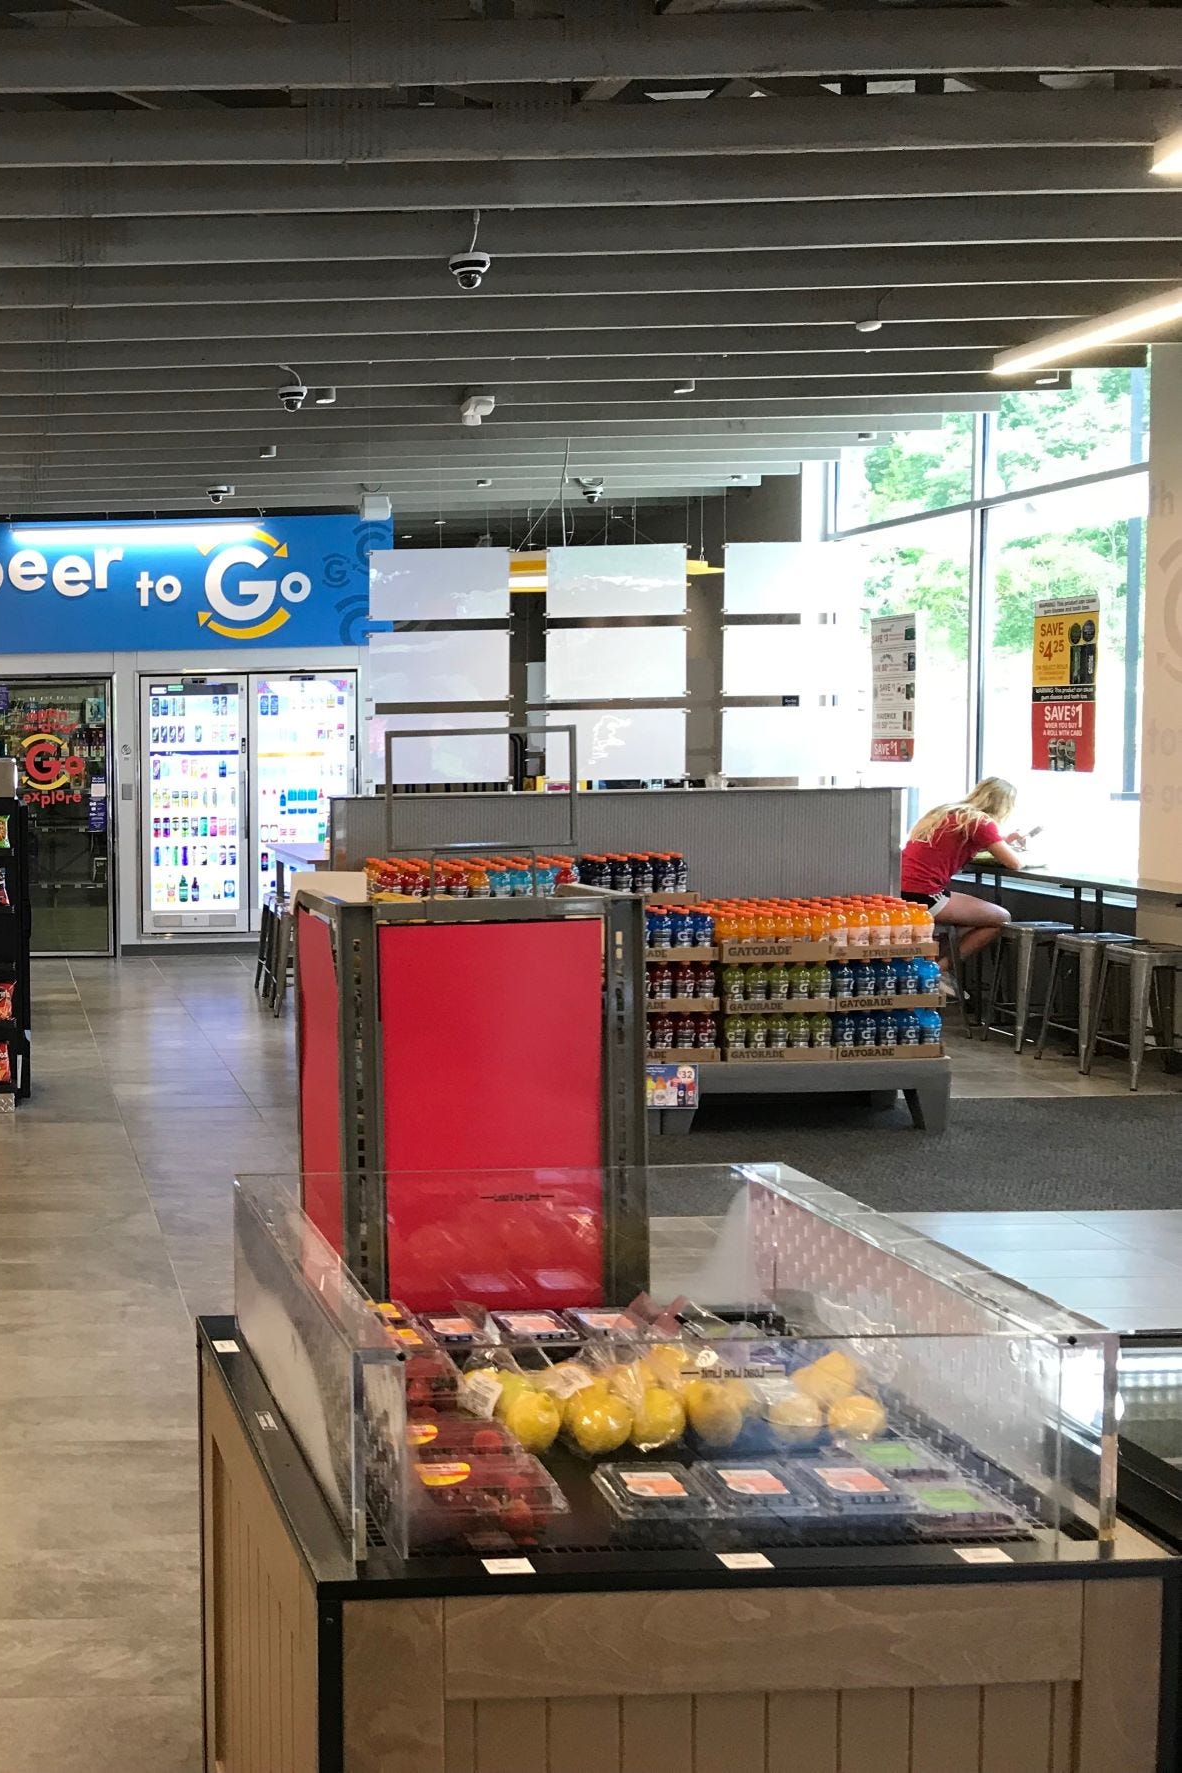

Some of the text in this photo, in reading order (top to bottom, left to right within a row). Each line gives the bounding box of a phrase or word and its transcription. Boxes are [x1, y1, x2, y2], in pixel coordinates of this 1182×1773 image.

[136, 571, 181, 606] to
[204, 545, 311, 620] Go
[1040, 622, 1064, 637] SAVE
[1044, 703, 1082, 728] SAVE $1
[874, 743, 890, 755] SAVE
[25, 742, 85, 781] Go
[23, 790, 82, 808] explore
[728, 945, 793, 957] GATORADE
[729, 1002, 784, 1011] GATORADE
[839, 998, 893, 1008] GATORADE
[730, 1050, 785, 1059] GATORADE
[840, 1048, 895, 1058] GATORADE
